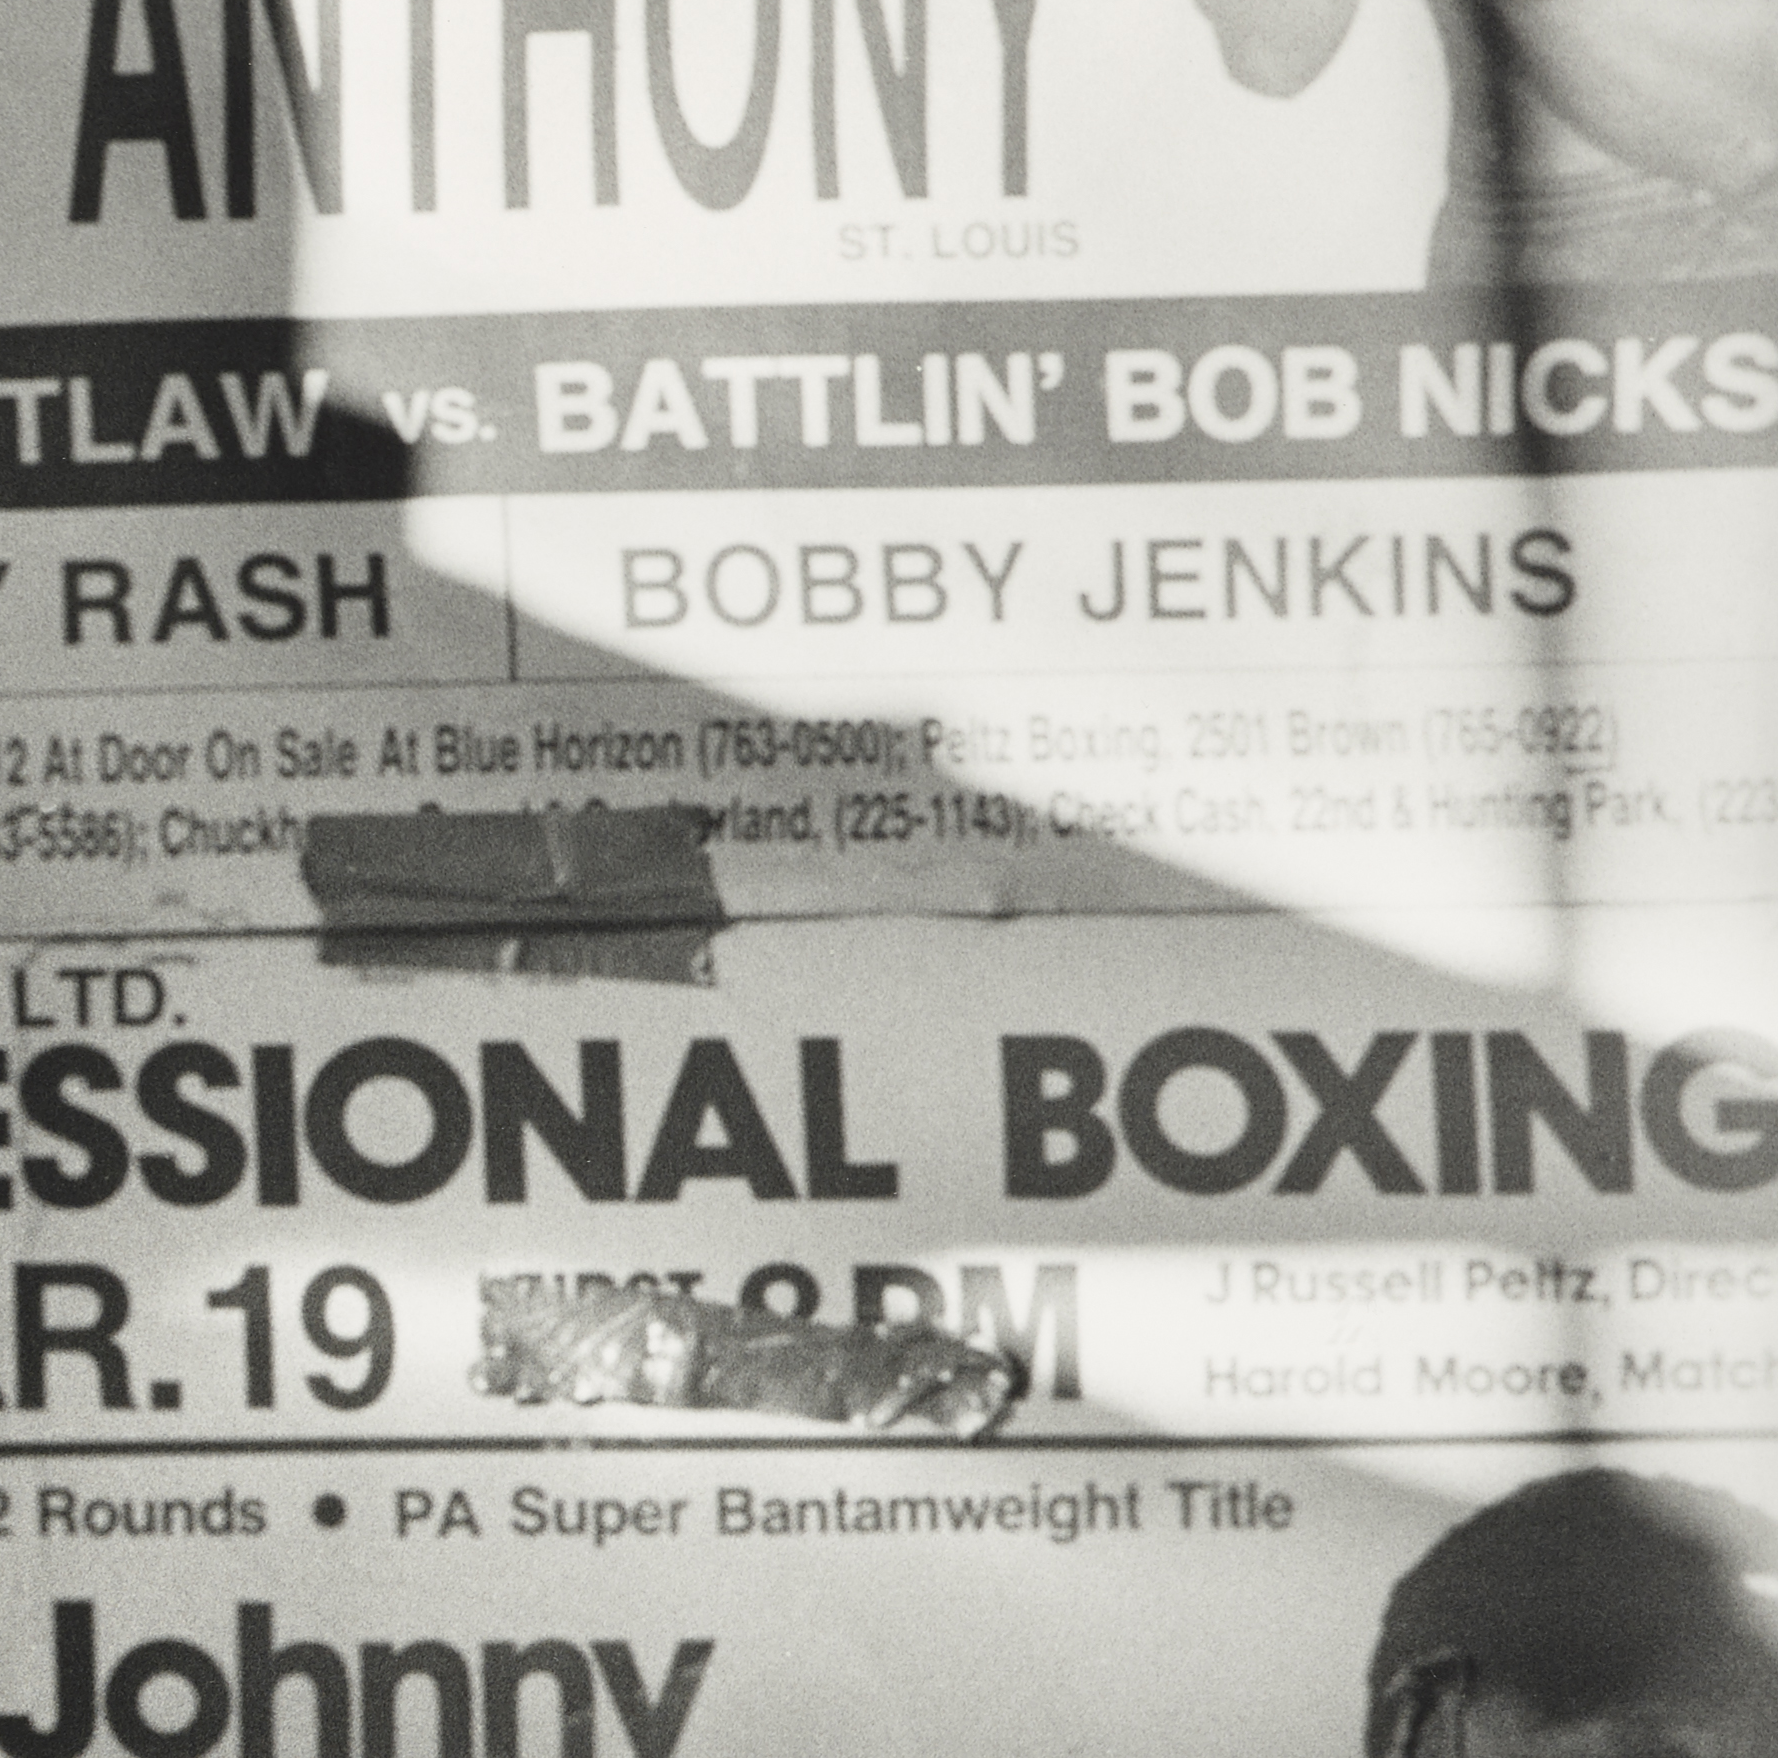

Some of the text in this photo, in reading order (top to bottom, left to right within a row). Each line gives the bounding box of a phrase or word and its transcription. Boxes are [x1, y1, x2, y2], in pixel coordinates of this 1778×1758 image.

[840, 221, 1080, 261] ST. LOUIS
[1103, 341, 1363, 445] BOB
[61, 549, 395, 647] RASH
[618, 539, 1026, 631] BOBBY
[1078, 523, 1581, 621] JENKINS
[43, 733, 84, 785] At
[98, 729, 193, 785] Door
[205, 726, 263, 783] On
[275, 724, 357, 781] Sale
[379, 724, 421, 777] At
[434, 721, 520, 775] Blue
[534, 719, 685, 775] Horizon
[919, 715, 1015, 765] Peltz
[1186, 710, 1267, 759] 2501
[1286, 708, 1411, 757] Brown
[1048, 791, 1158, 843] Check
[1290, 784, 1375, 833] 22nd
[1430, 782, 1570, 841] Hunting
[12, 967, 188, 1031] LTD.
[996, 1024, 1778, 1203] BOXING
[1251, 1259, 1444, 1307] Russell
[1467, 1253, 1635, 1317] Peltz,
[205, 1263, 399, 1415] 19
[1203, 1349, 1622, 1417] Harold Moore,
[37, 1486, 269, 1537] Rounds
[394, 1488, 483, 1539] PA
[510, 1484, 688, 1547] Super
[715, 1483, 1144, 1550] Bantamweight
[1166, 1479, 1299, 1533] Title
